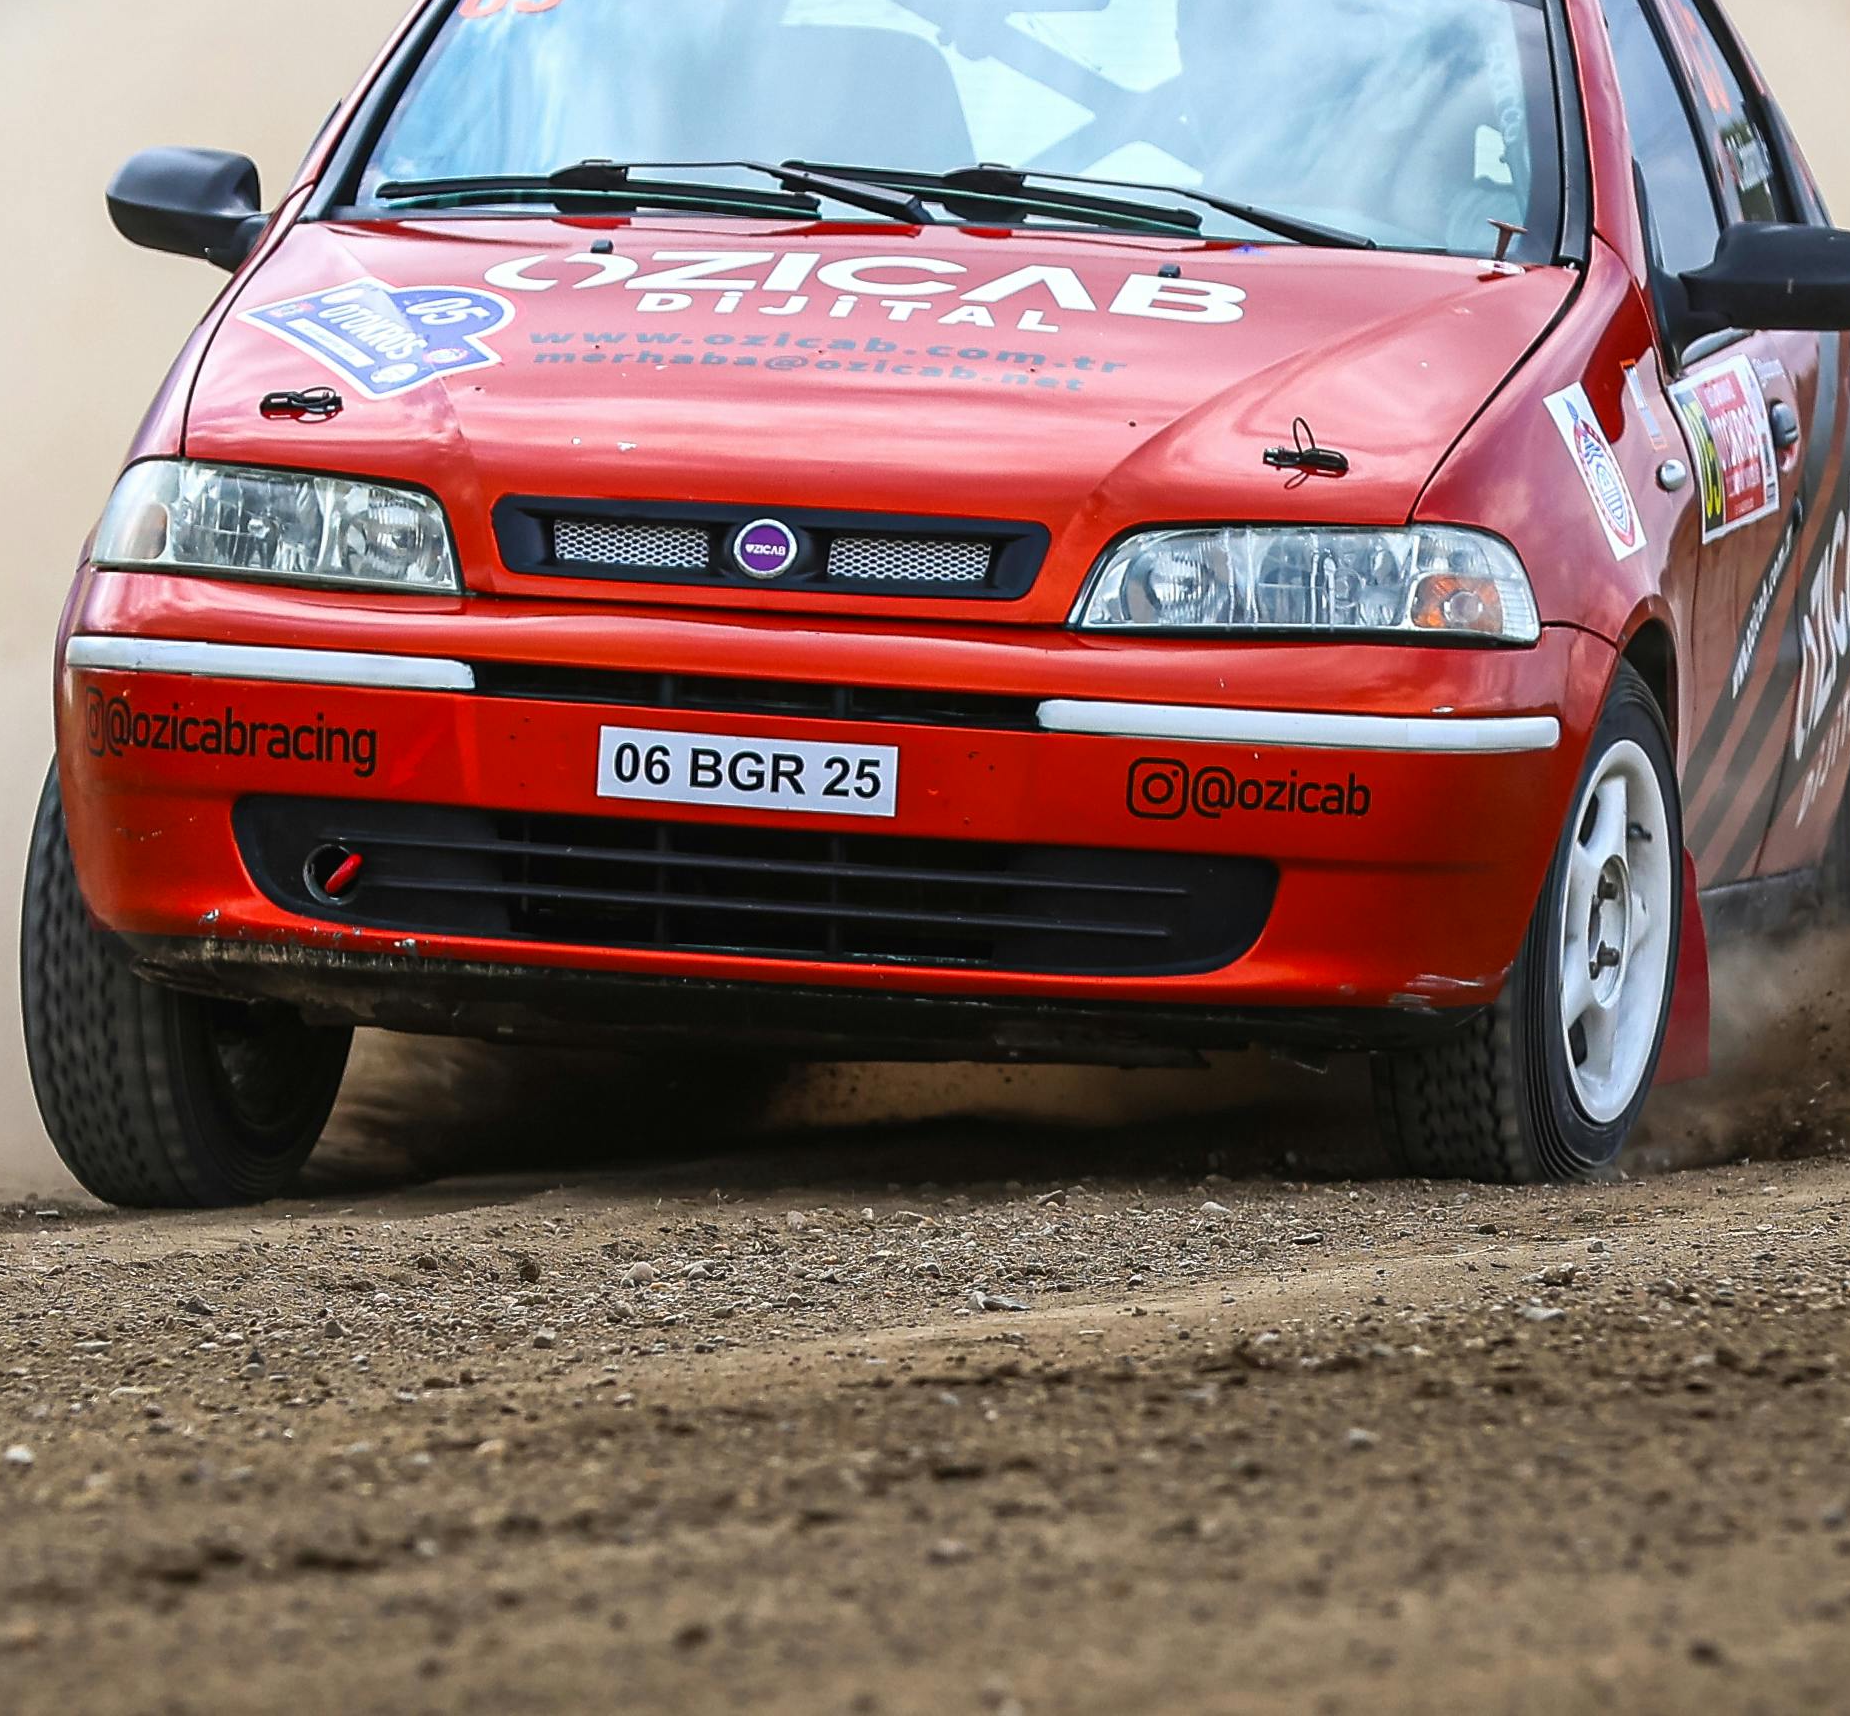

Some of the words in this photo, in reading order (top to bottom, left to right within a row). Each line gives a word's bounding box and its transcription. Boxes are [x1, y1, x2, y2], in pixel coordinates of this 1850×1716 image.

[406, 297, 490, 325] 05
[484, 251, 1247, 324] OZICAB
[318, 303, 428, 360] OTOKROS
[529, 331, 1127, 374] www.ozicab.com.tr
[533, 351, 1085, 392] merhaba@ozicab.net
[104, 695, 377, 777] @ozicabracing
[614, 742, 671, 785] 06
[689, 747, 806, 795] BGR
[821, 756, 882, 799] 25
[1192, 766, 1371, 818] @ozicab
